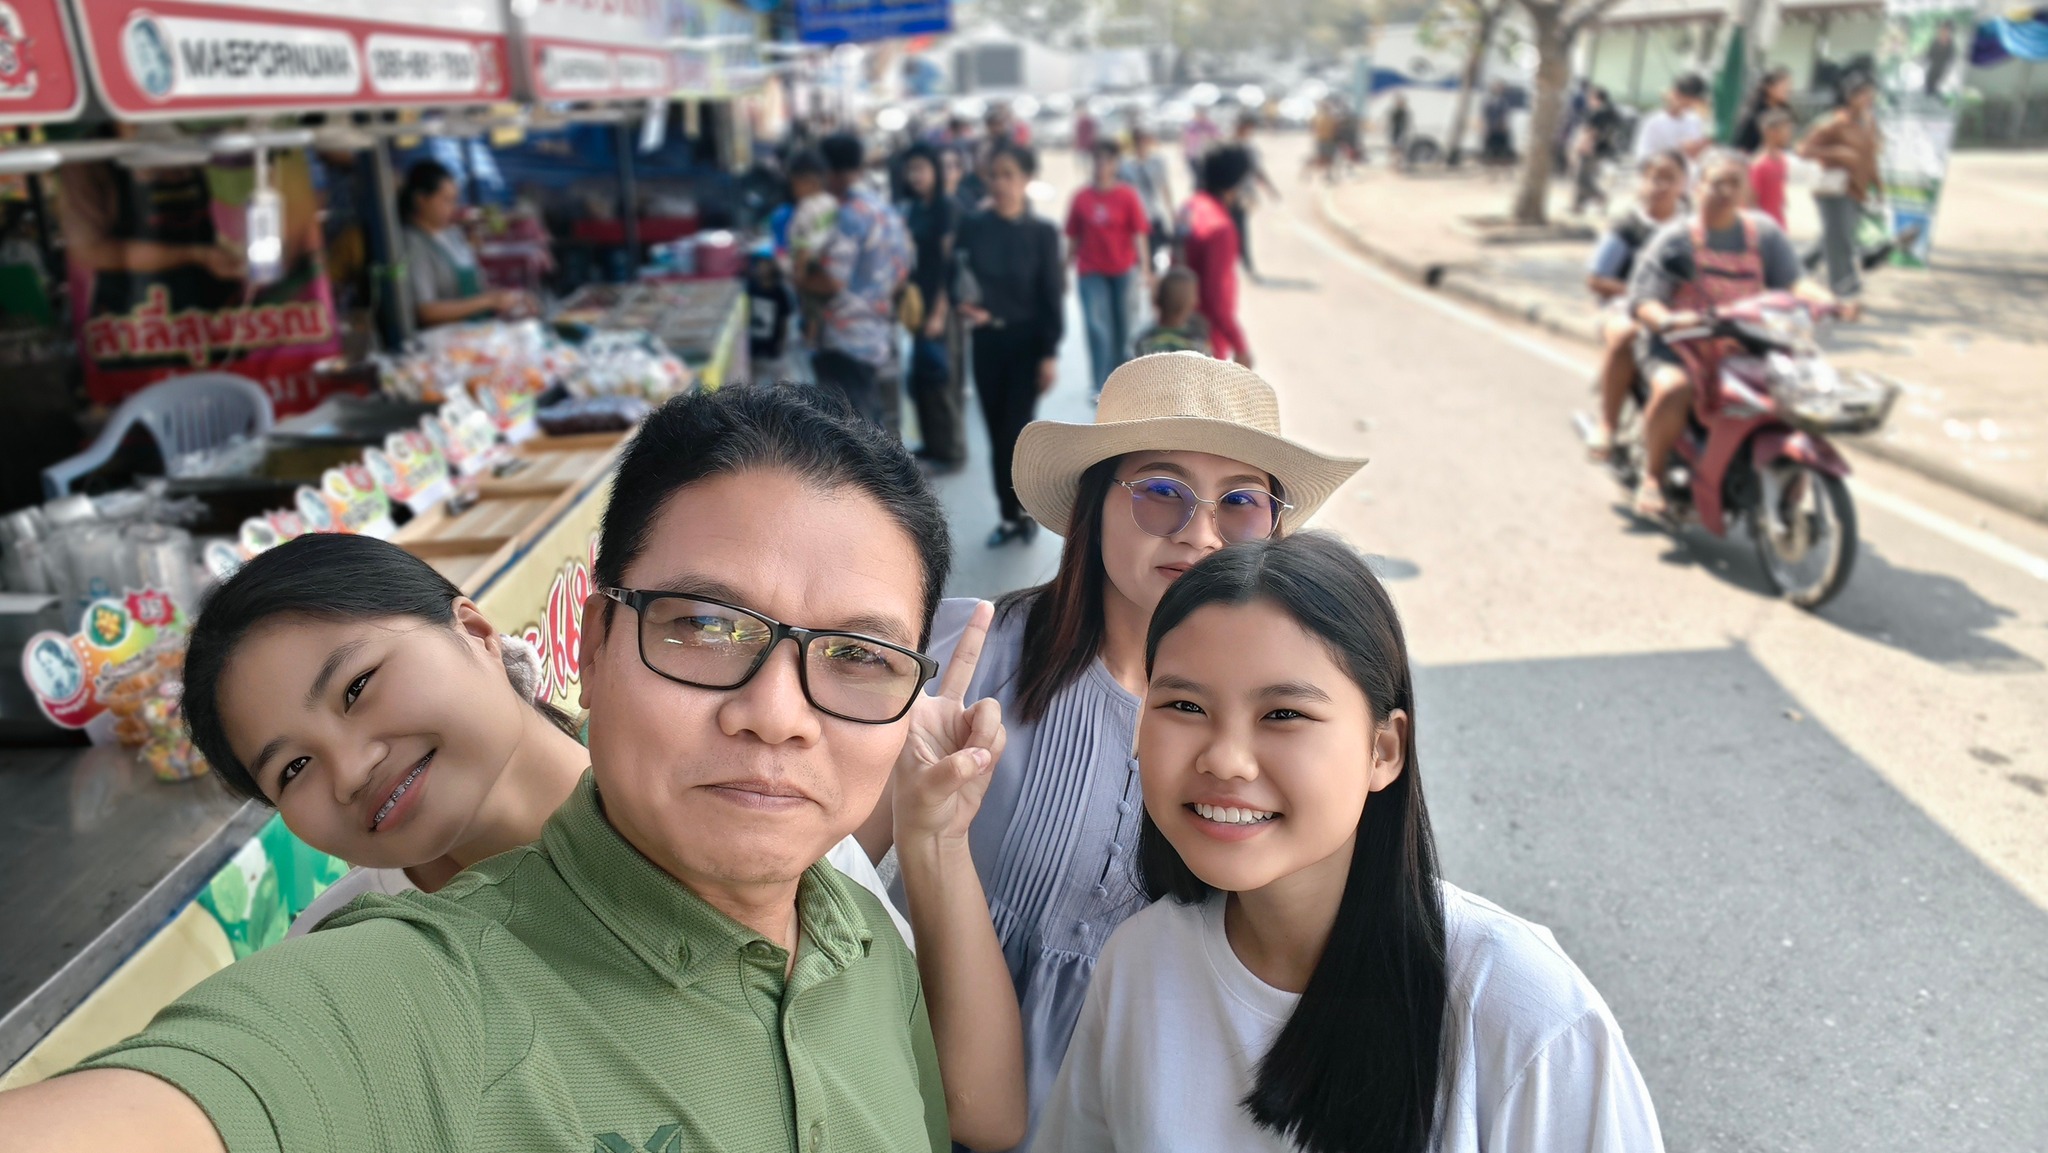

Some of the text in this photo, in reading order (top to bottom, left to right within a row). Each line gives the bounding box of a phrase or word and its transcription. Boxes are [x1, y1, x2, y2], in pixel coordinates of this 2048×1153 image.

[86, 286, 328, 368] สาลี่สุพรรณ
